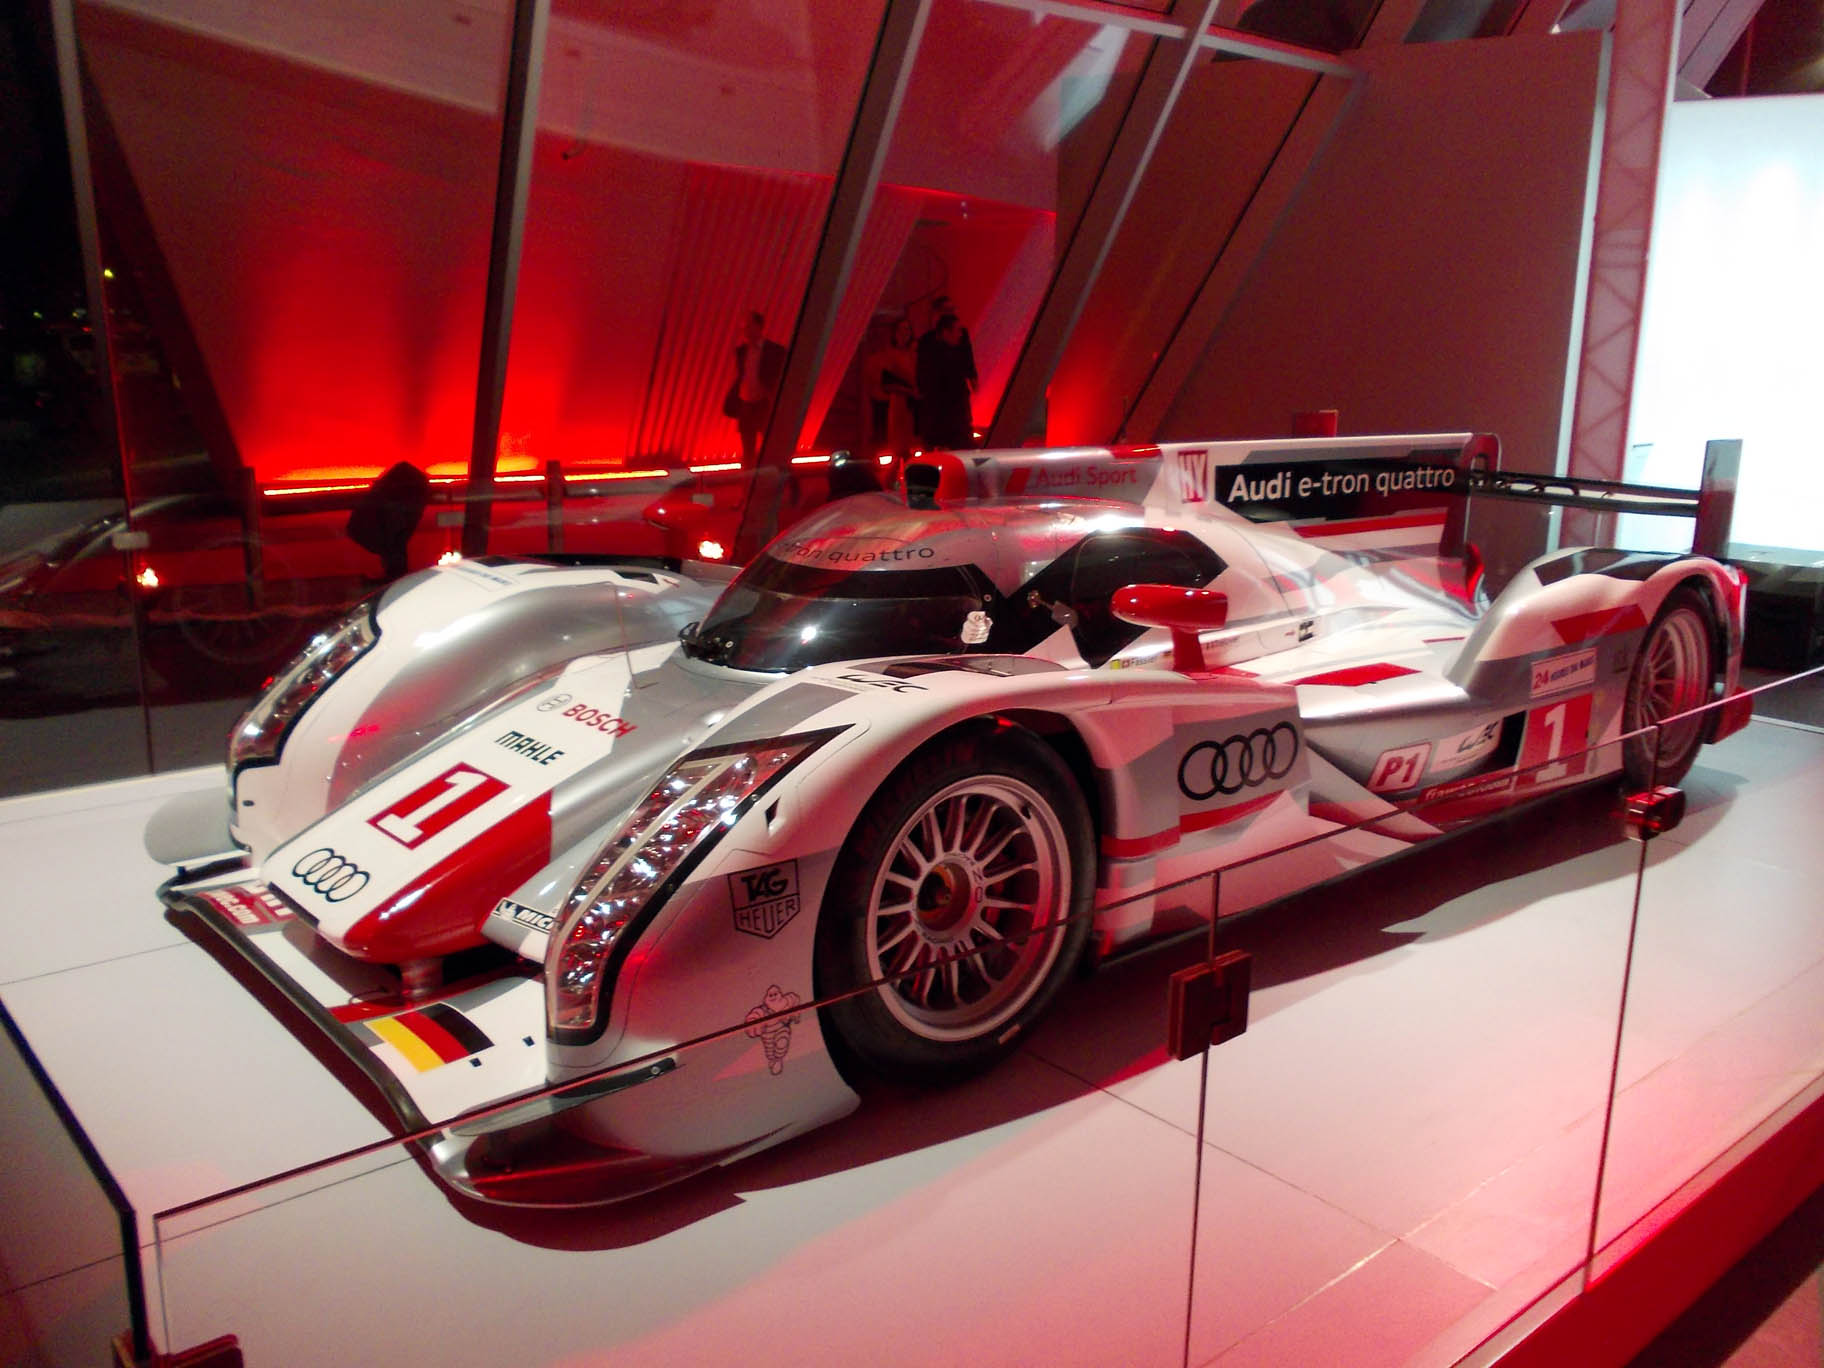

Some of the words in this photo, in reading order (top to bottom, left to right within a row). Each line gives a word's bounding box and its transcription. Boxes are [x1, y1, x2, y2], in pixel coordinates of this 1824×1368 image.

[1036, 466, 1081, 488] Audi
[1087, 465, 1138, 487] Sport
[1227, 471, 1293, 503] Audi
[1298, 471, 1369, 497] e-tron
[1376, 467, 1456, 497] quattro
[828, 547, 935, 564] quattro
[562, 703, 639, 739] BOSCH
[494, 730, 566, 767] MAHLE
[1537, 703, 1577, 784] 1
[1376, 753, 1421, 788] P1
[376, 770, 490, 844] 1
[741, 867, 789, 902] TAG
[515, 908, 555, 931] MIC
[738, 898, 797, 934] HEUER
